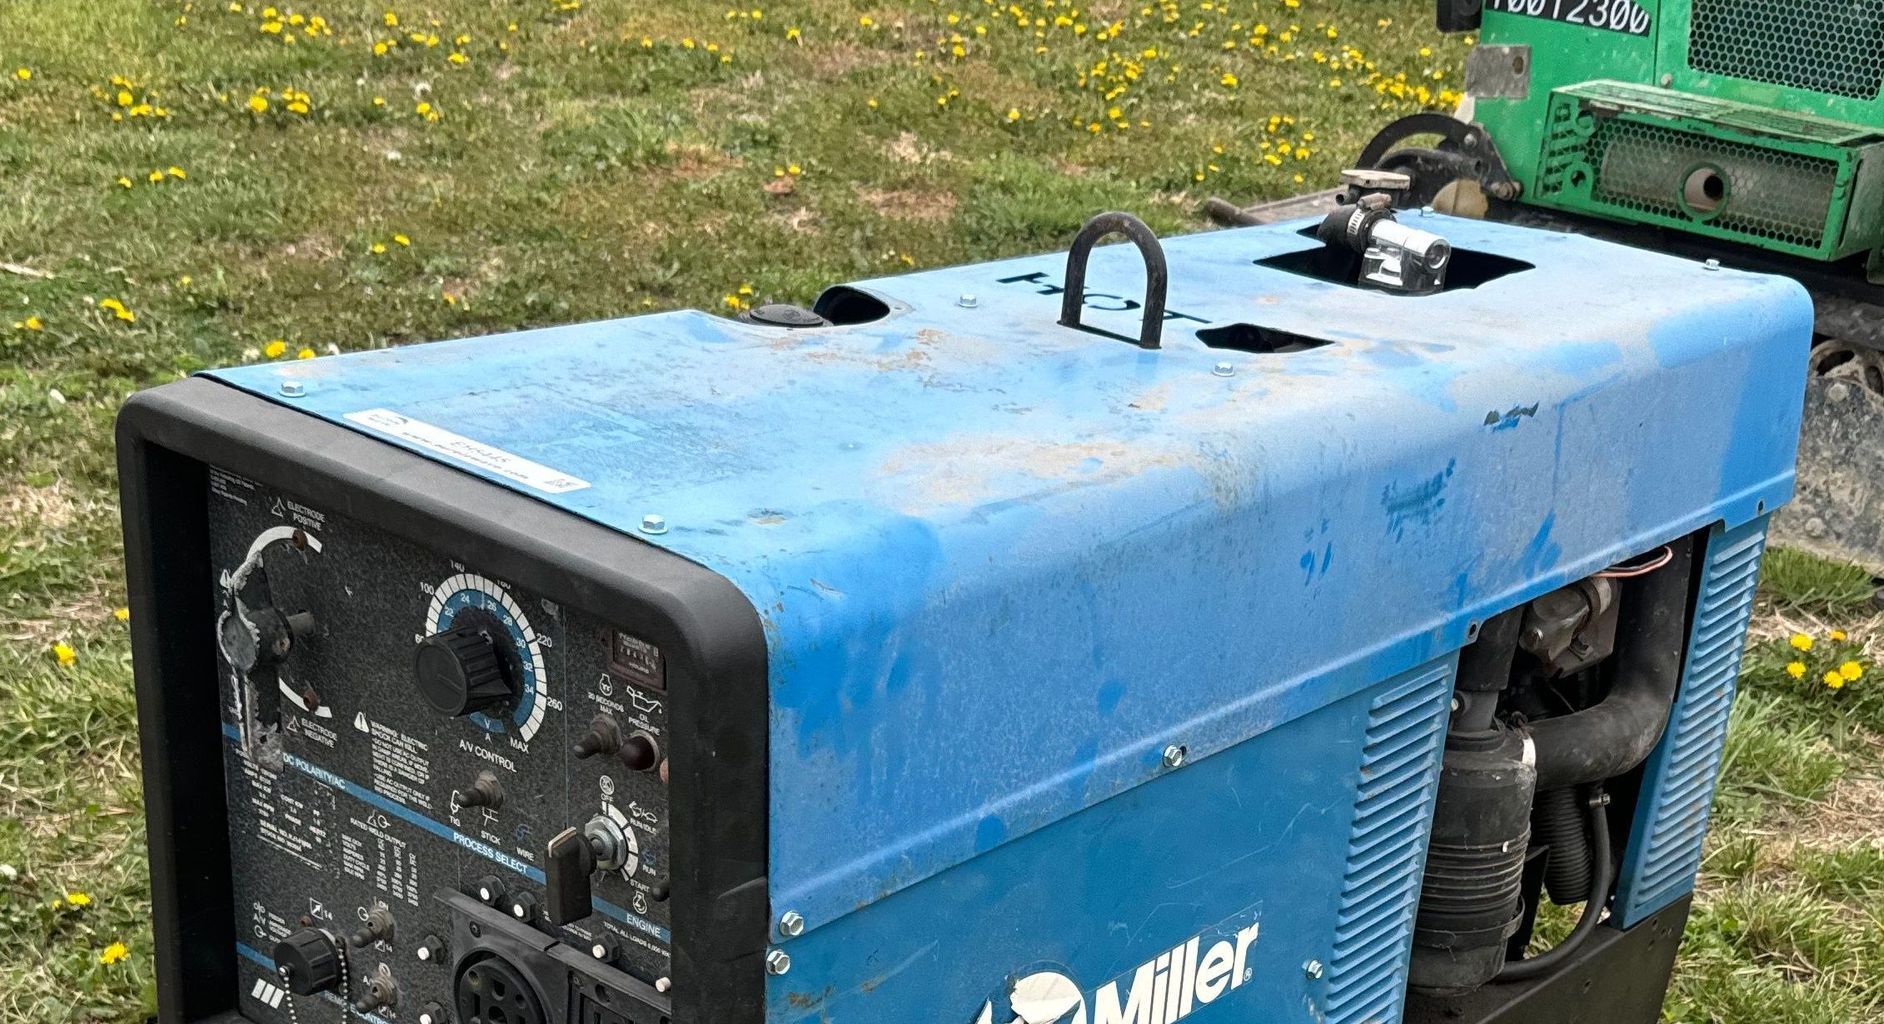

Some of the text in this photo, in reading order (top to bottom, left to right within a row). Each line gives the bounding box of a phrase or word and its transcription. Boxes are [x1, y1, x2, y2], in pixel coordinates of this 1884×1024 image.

[287, 501, 325, 522] ELECTRODE
[293, 513, 322, 531] POSITIVE
[420, 582, 435, 596] 100
[461, 593, 470, 604] 24
[487, 600, 497, 612] 26
[445, 606, 454, 617] 22
[516, 637, 526, 648] 30
[536, 633, 552, 648] 220
[523, 661, 534, 672] 32
[524, 684, 535, 695] 34
[547, 697, 563, 711] 260
[301, 718, 337, 742] ELECTRODE
[628, 716, 661, 736] PRESSURE
[304, 729, 335, 749] NEGATIVE
[510, 736, 529, 754] MAX
[459, 739, 517, 773] A/V CONTROL
[282, 752, 294, 766] DC
[295, 758, 346, 790] POLARITY/AC
[601, 793, 613, 803] OFF
[480, 830, 500, 846] STICK
[453, 831, 528, 874] PROCESS SELECT
[516, 846, 534, 862] WIRE
[642, 864, 656, 877] RUN
[630, 879, 650, 893] START
[626, 912, 661, 938] ENGINE
[324, 990, 360, 1015] REMOE
